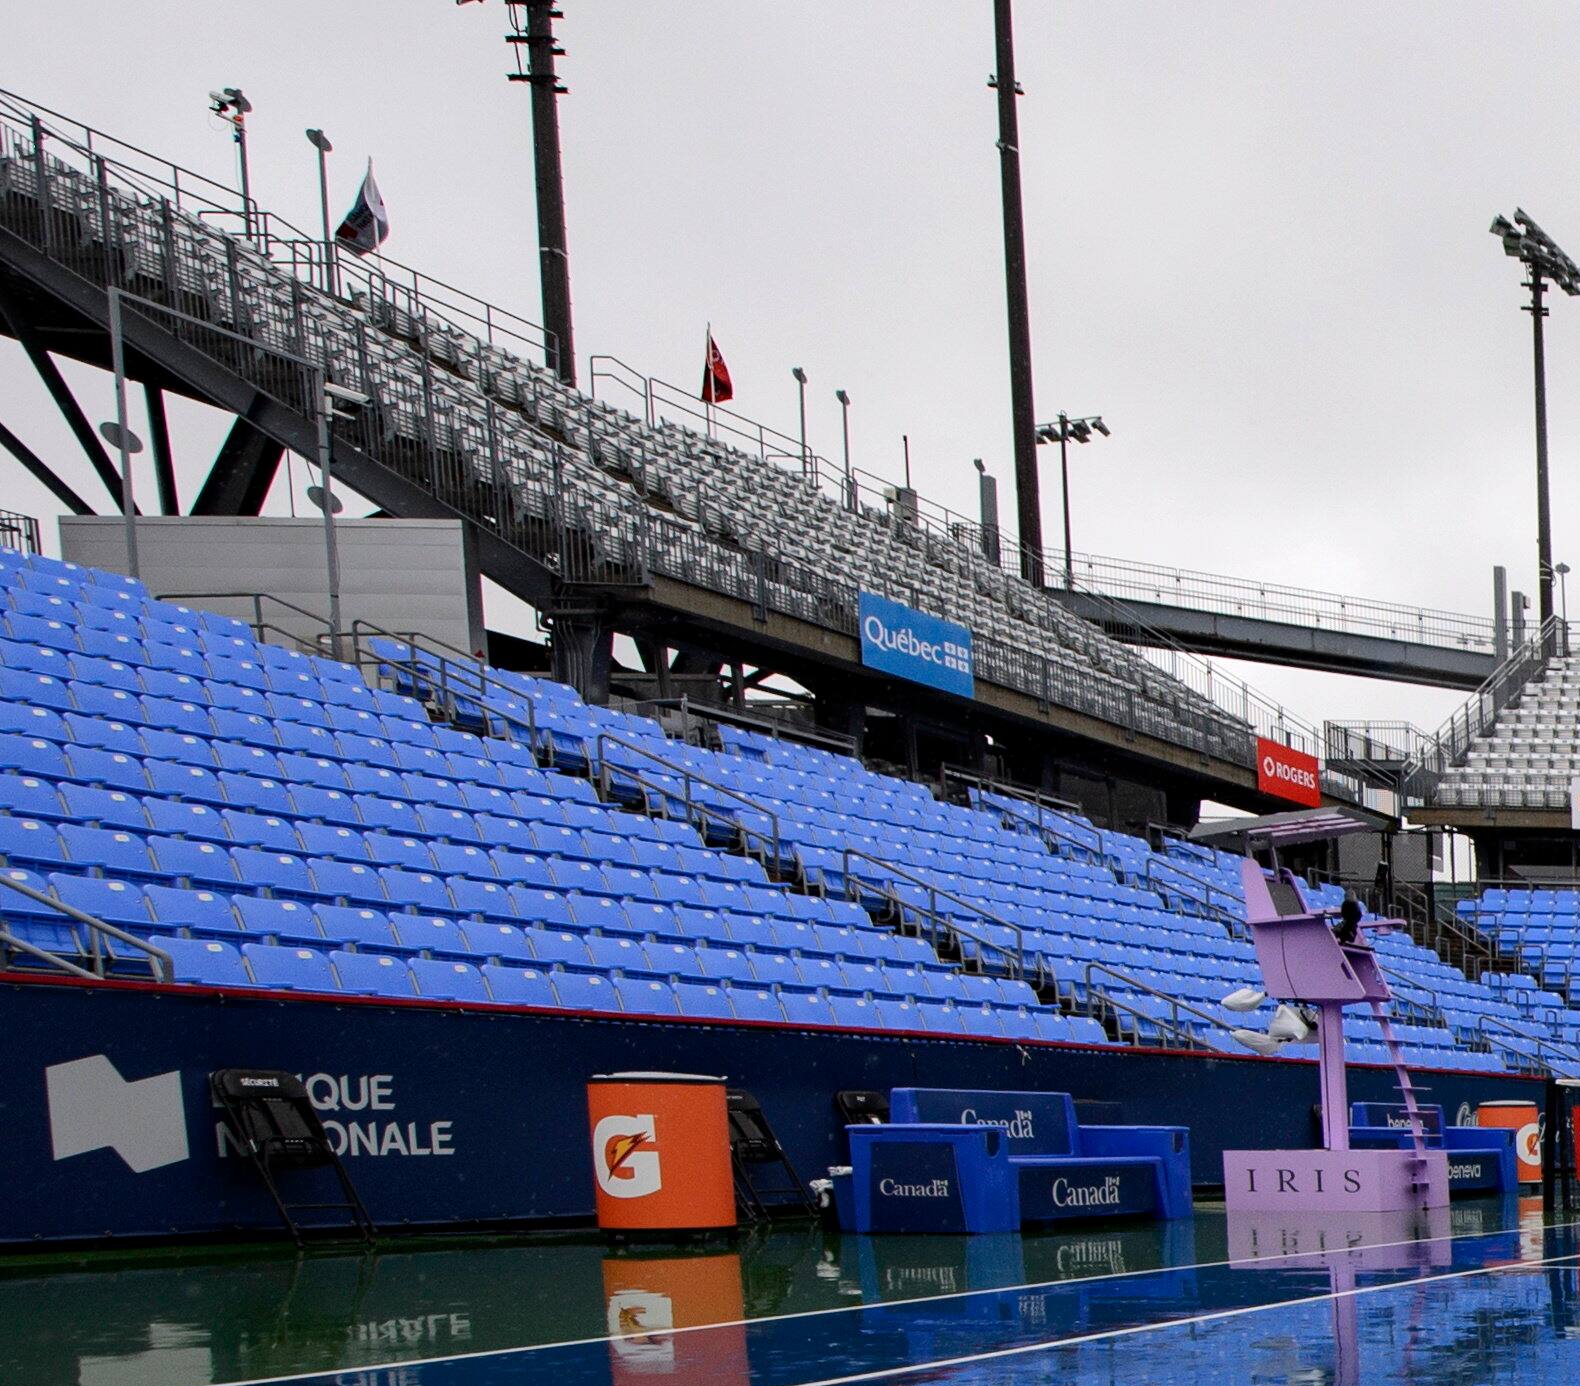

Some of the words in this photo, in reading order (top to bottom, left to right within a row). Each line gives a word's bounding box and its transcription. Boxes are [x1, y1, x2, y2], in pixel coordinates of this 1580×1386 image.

[865, 616, 942, 665] Québec
[1276, 762, 1315, 789] ROGERS
[215, 1120, 455, 1157] NONALE
[593, 1114, 662, 1198] G
[880, 1179, 950, 1197] Canada
[1052, 1176, 1120, 1207] Canada
[1246, 1168, 1361, 1193] IRIS
